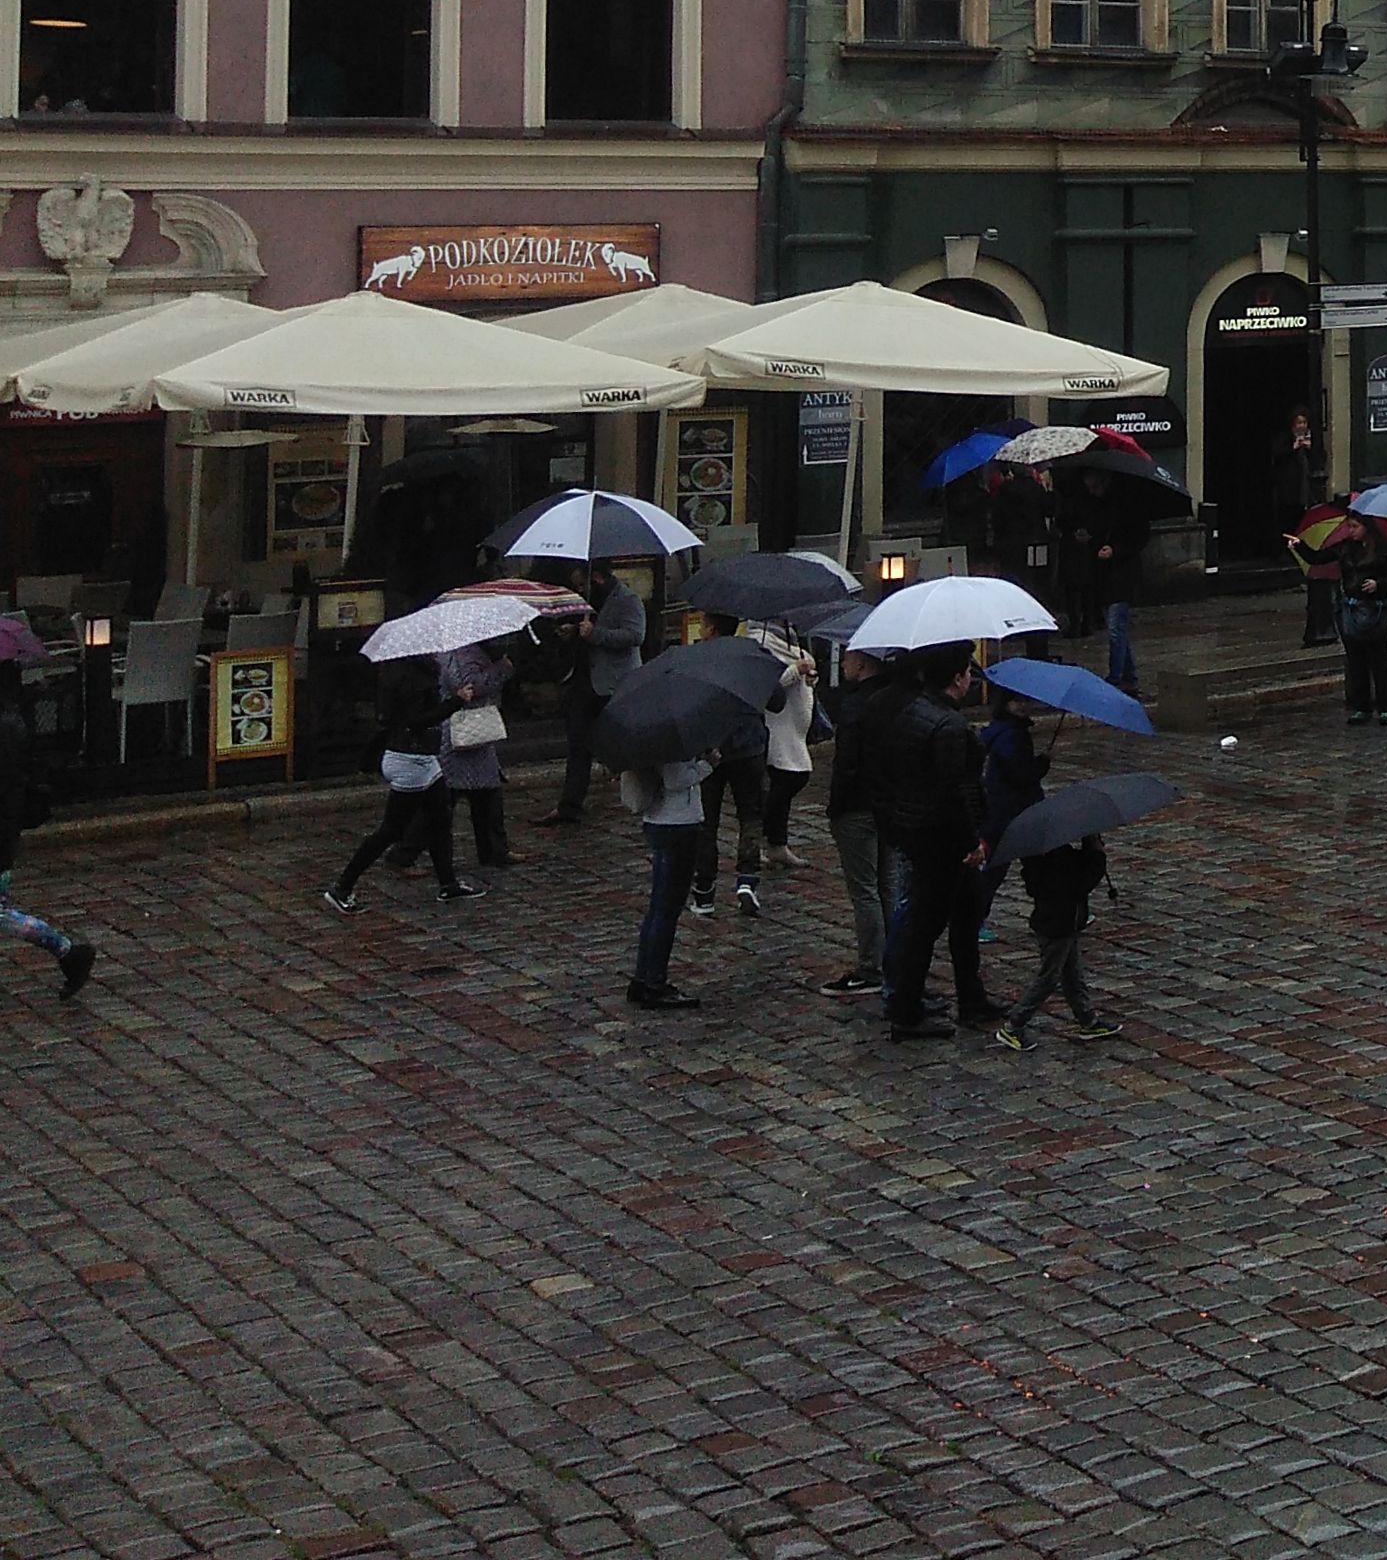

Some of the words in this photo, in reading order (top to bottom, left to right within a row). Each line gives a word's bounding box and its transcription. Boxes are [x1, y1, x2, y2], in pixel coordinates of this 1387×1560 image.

[516, 271, 586, 285] NAPITKI
[1245, 306, 1281, 317] PIWKO
[1218, 316, 1308, 332] NAPRZECIWKO
[771, 362, 821, 376] WARKA
[1066, 378, 1116, 389] WARKA
[229, 391, 290, 405] WARKA
[585, 390, 642, 403] WARKA
[802, 392, 852, 406] ANTYK
